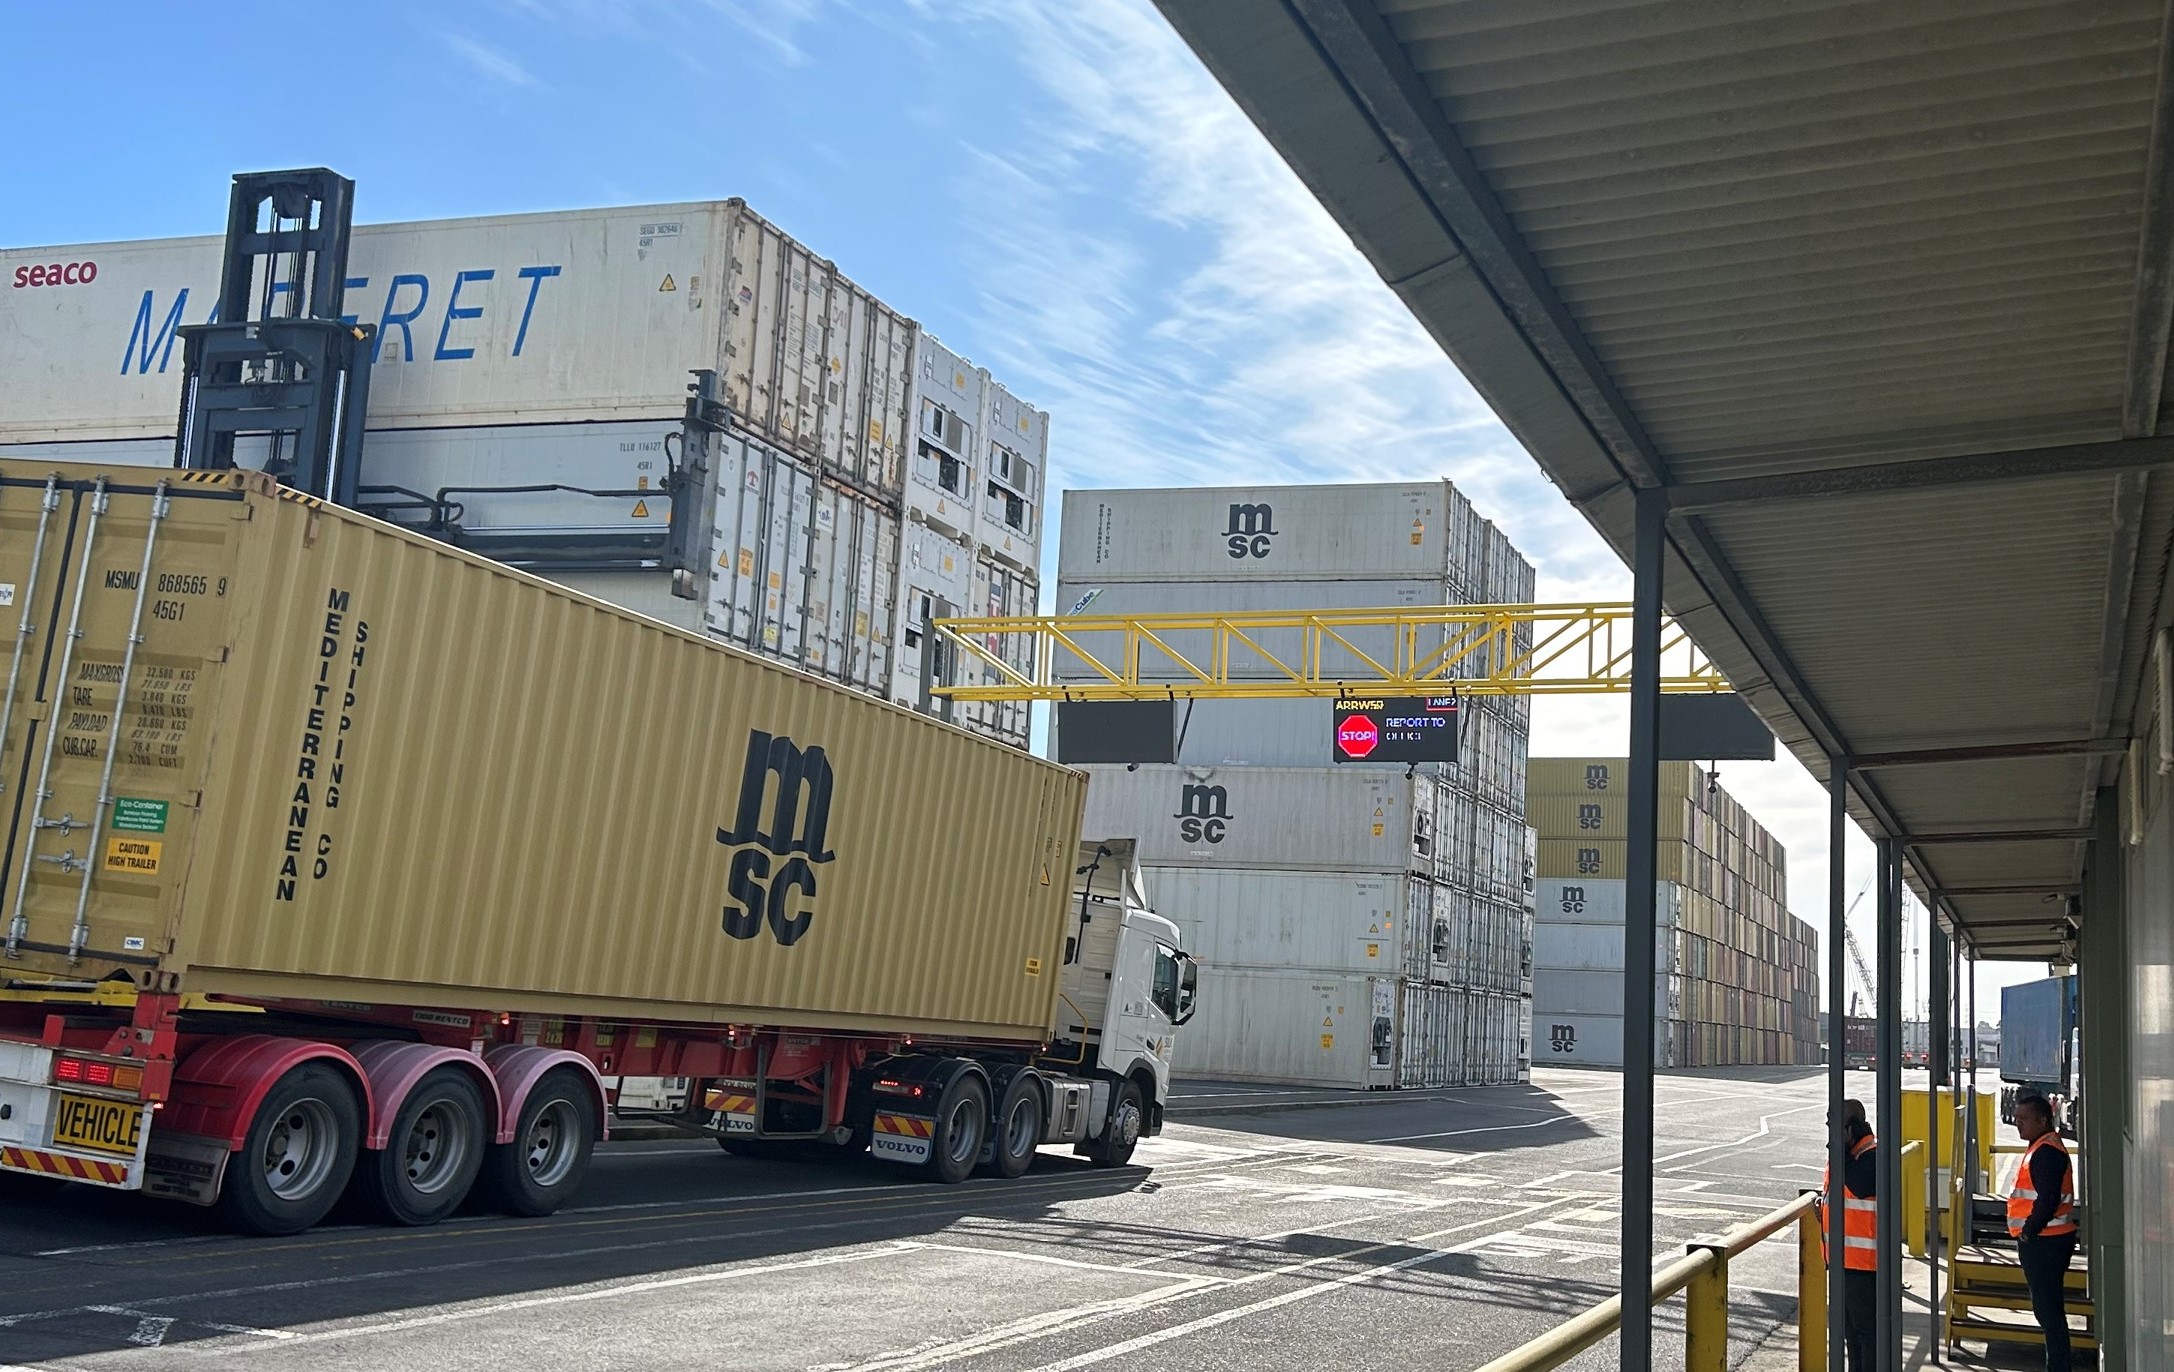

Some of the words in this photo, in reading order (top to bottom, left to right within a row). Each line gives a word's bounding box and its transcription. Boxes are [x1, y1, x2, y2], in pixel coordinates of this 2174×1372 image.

[13, 261, 97, 288] seaco
[121, 266, 561, 376] MRET
[105, 570, 141, 590] MSMU
[158, 573, 207, 595] 868565
[217, 577, 227, 596] 9
[153, 600, 185, 621] 45G1
[180, 670, 196, 681] KGS
[73, 686, 94, 707] TARE
[171, 695, 187, 705] KGS
[67, 712, 108, 733] PAYLOAD
[171, 719, 187, 731] KGS
[325, 621, 369, 809] SHIPPING
[1386, 717, 1428, 728] REPORT
[1430, 717, 1446, 728] TO
[276, 587, 350, 902] MEDITERRANEAN
[1341, 731, 1375, 741] STOP!
[118, 842, 150, 856] CAUTION
[313, 834, 331, 880] CO
[107, 855, 126, 868] HIGH
[127, 857, 157, 870] TRAILER
[59, 1100, 143, 1146] VEHICLE
[876, 1139, 926, 1155] VOLVO
